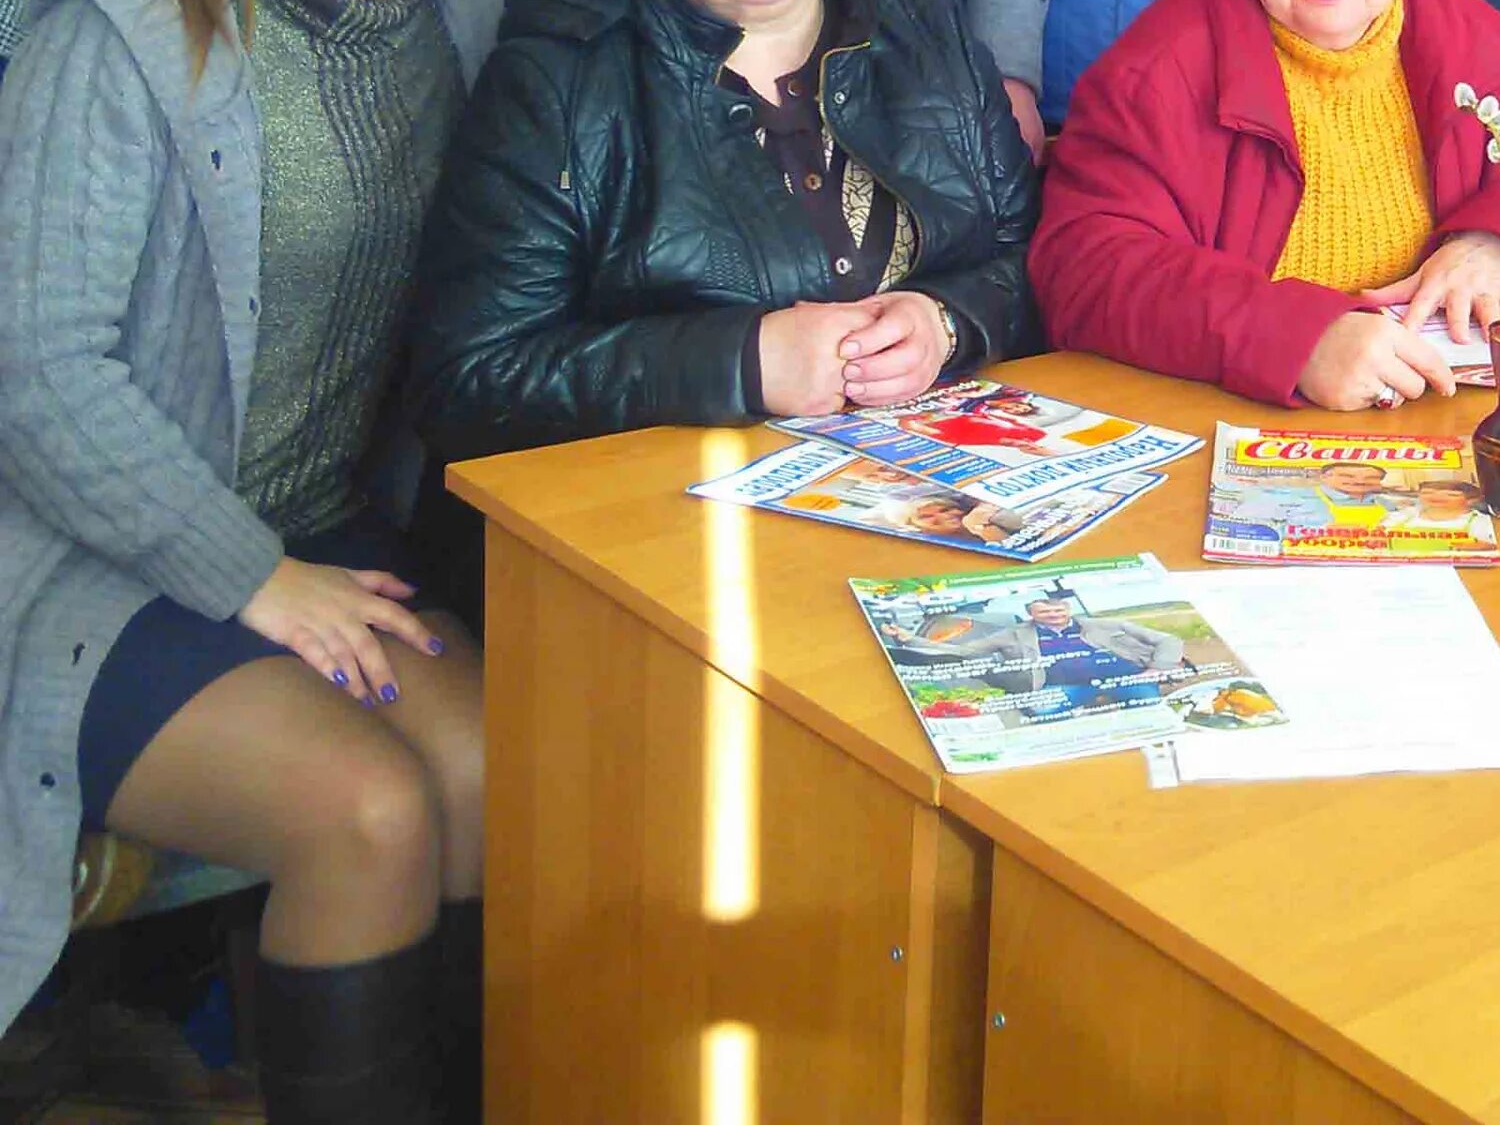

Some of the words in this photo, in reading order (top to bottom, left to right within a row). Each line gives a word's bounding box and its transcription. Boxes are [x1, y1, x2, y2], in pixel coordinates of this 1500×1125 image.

[1061, 435, 1181, 475] Народный
[1244, 439, 1448, 462] Сваты
[980, 460, 1060, 499] доктор
